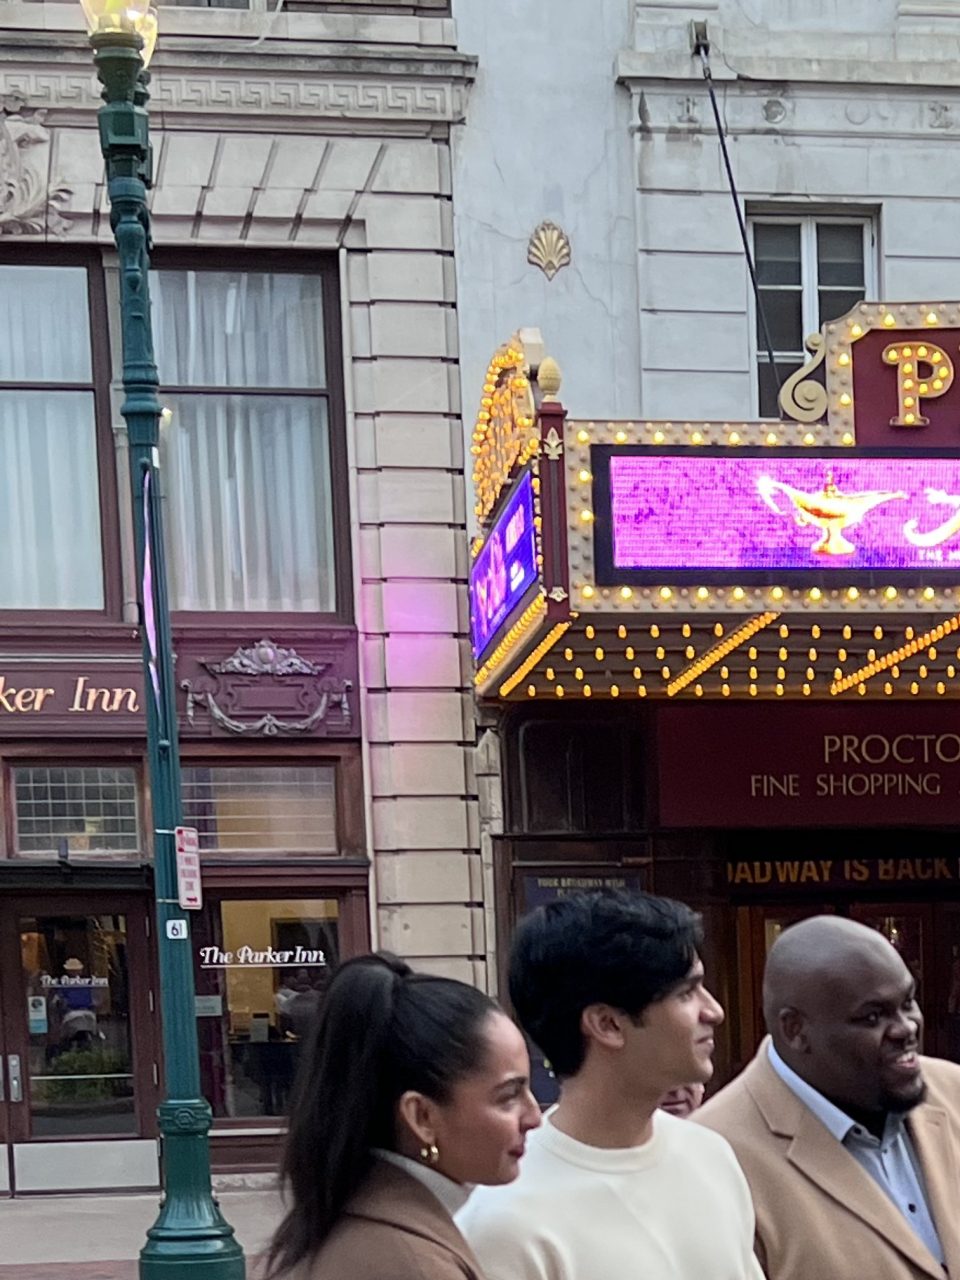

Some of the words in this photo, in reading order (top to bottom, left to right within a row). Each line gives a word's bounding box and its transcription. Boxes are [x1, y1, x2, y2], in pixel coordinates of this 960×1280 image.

[67, 676, 139, 712] Inn
[751, 774, 800, 797] FINE
[816, 772, 941, 797] SHOPPING
[200, 946, 233, 964] The
[236, 945, 294, 964] Parker
[294, 945, 327, 963] Inn
